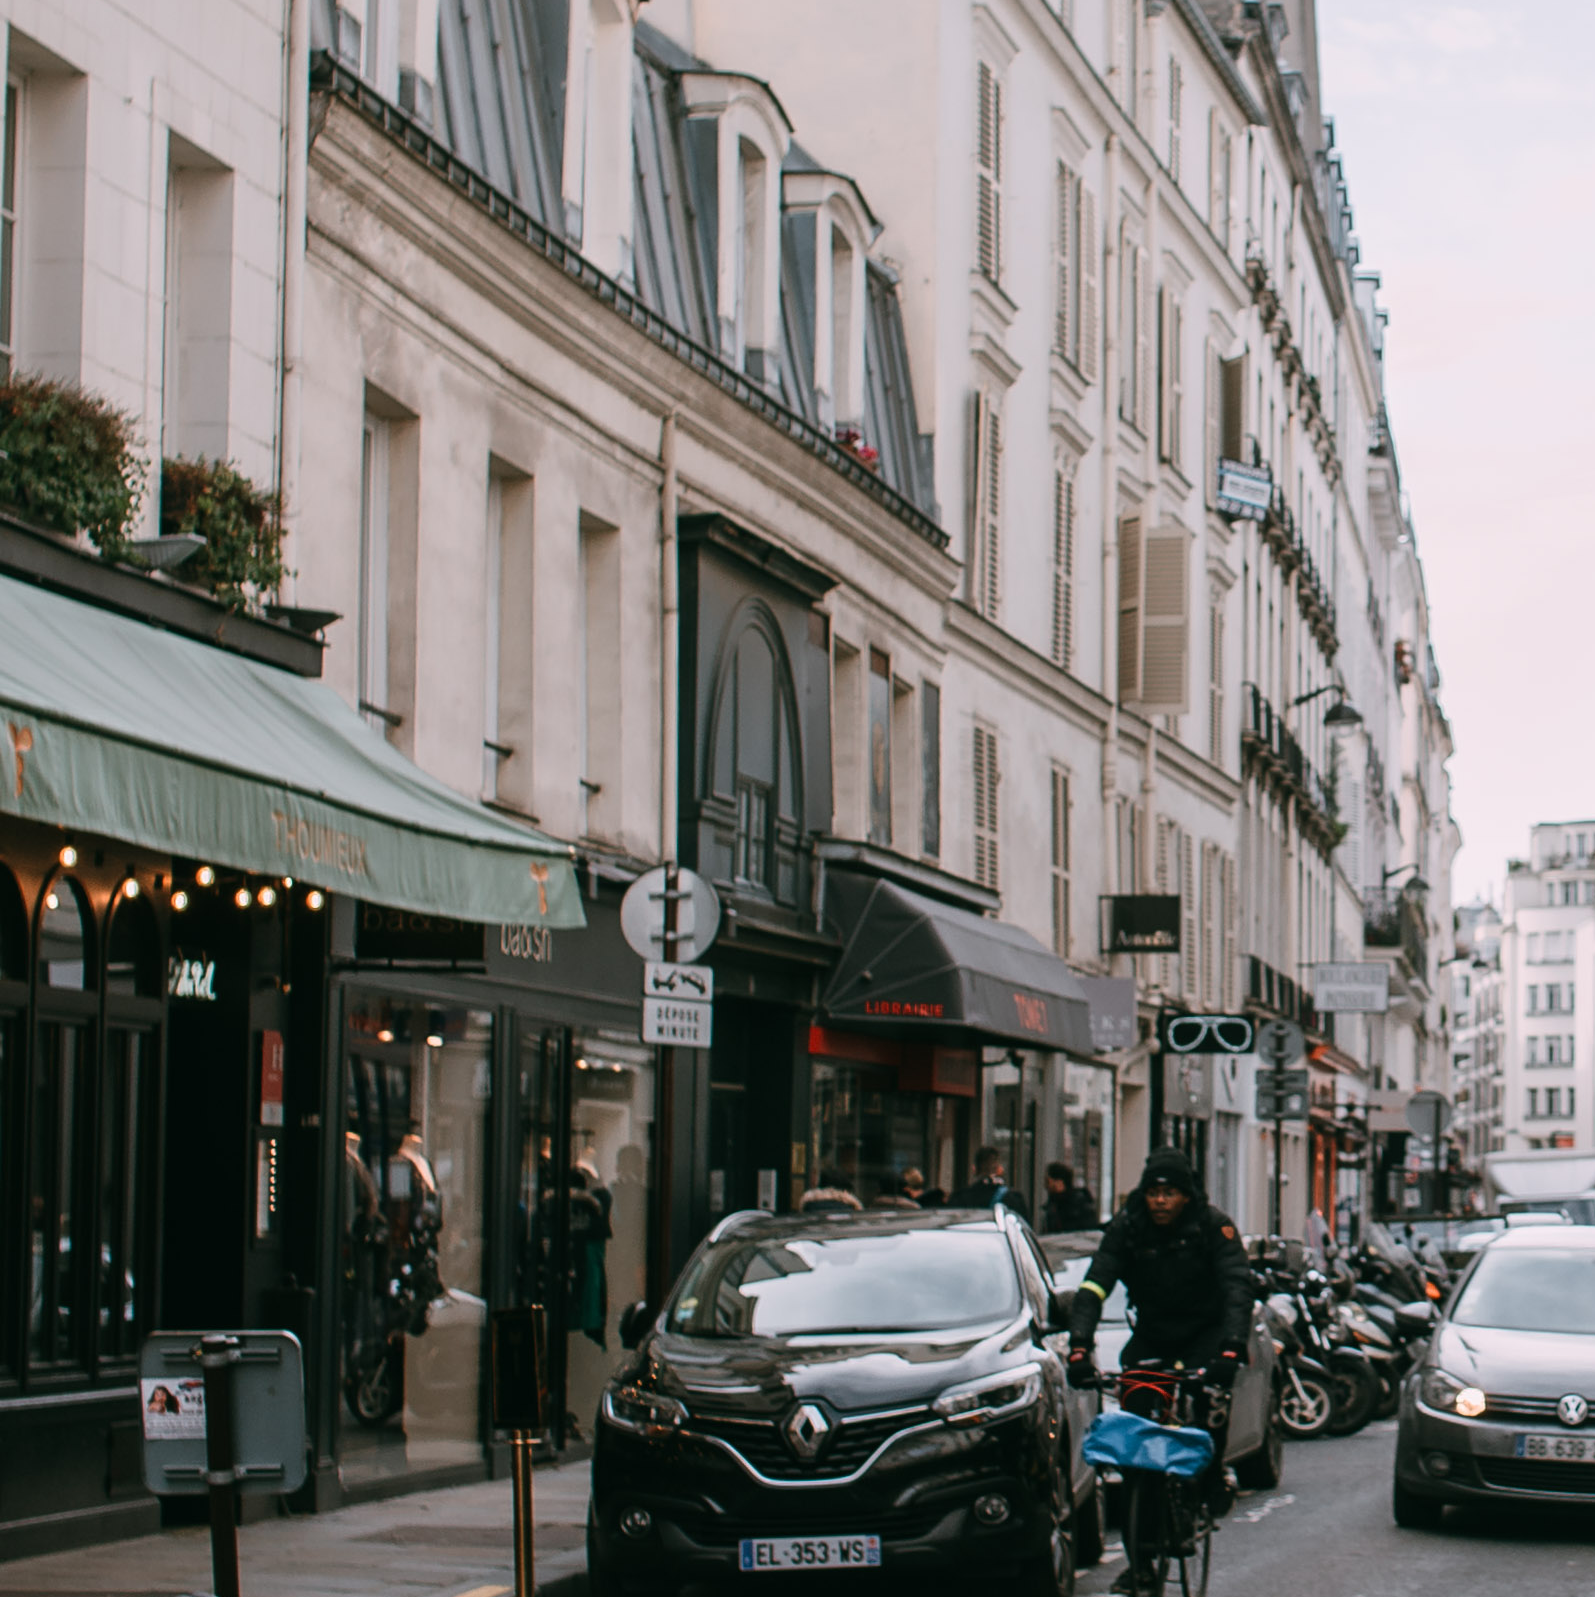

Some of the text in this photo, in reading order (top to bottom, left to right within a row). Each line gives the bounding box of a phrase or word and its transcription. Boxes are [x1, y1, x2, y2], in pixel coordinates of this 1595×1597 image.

[271, 807, 368, 877] THOUMIEUX
[865, 1000, 943, 1017] LIBRAIRIE
[656, 1024, 698, 1040] MINUTE
